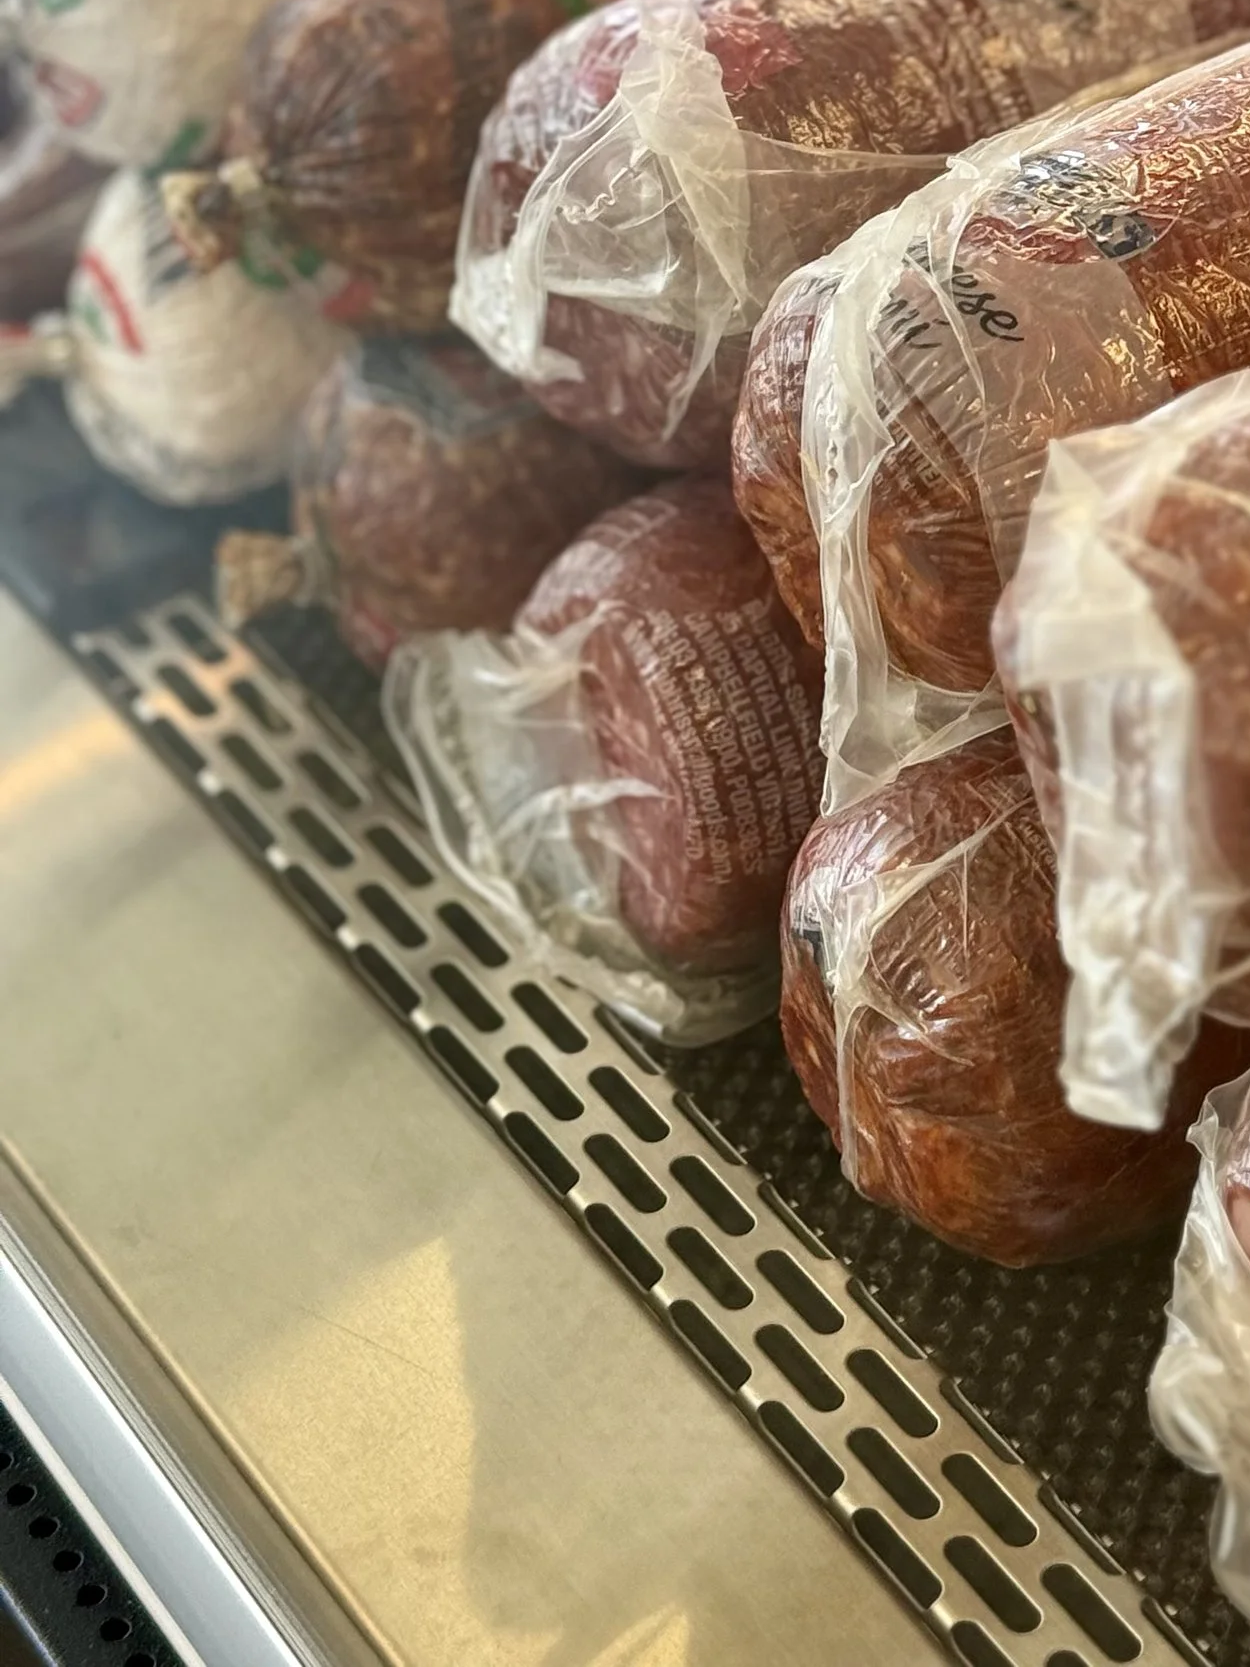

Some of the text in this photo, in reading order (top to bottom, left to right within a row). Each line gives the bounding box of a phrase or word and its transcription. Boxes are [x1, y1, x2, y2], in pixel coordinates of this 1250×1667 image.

[682, 609, 773, 773] CAMPBELLFIELD
[754, 770, 782, 811] VIC
[730, 633, 786, 726] CAPITAL
[768, 723, 802, 777] LINK
